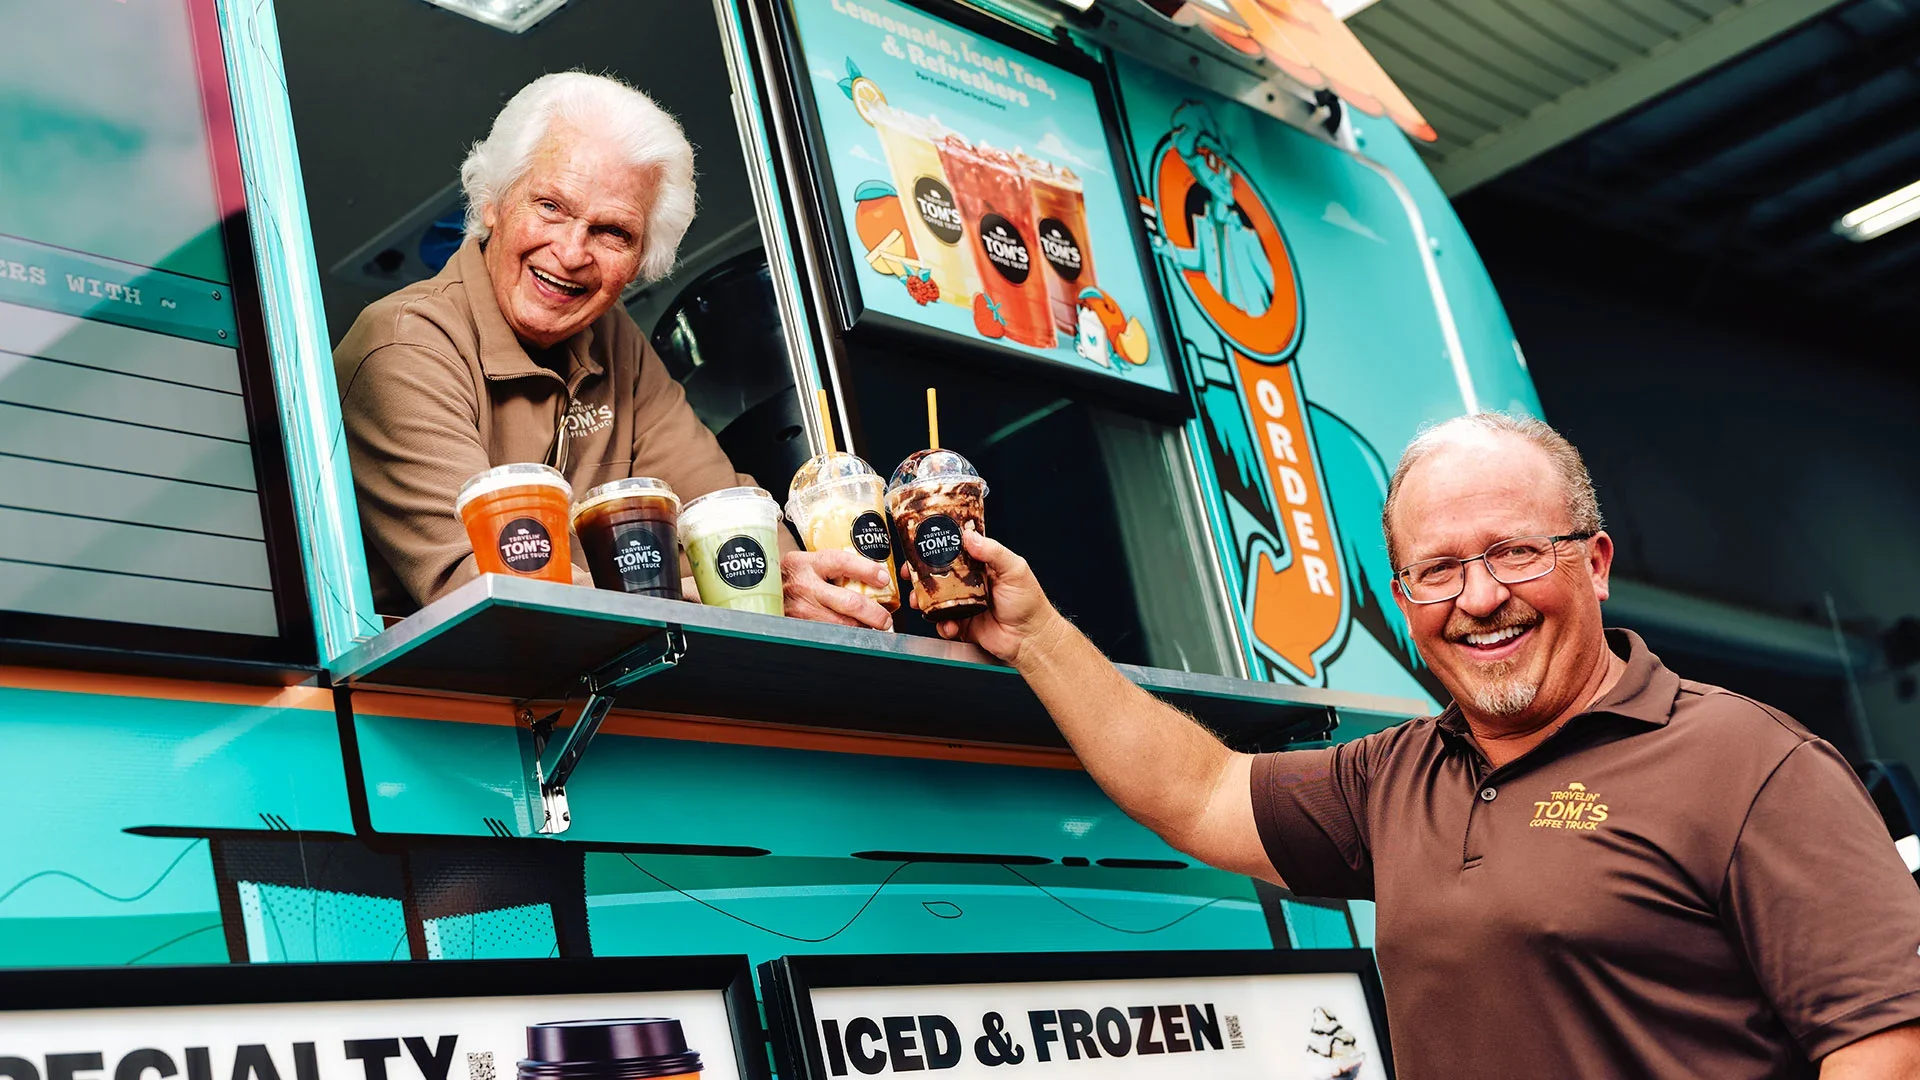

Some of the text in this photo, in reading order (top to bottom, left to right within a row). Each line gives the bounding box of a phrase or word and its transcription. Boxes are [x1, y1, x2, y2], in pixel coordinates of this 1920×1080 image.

[831, 0, 1057, 101] Lemonade, Iced Tea,
[881, 34, 1030, 108] & Refreshers
[917, 197, 962, 225] TOM'S
[982, 235, 1029, 264] TOM'S
[1040, 236, 1081, 263] TOM'S
[65, 274, 142, 305] WITH
[564, 404, 613, 430] OM'S
[570, 430, 588, 438] FFEE
[1256, 379, 1335, 597] ORDER
[855, 532, 890, 545] TOM'S
[917, 534, 961, 552] TOM'S
[501, 539, 551, 557] TOM'S
[922, 548, 941, 558] COFFEE
[507, 553, 529, 563] COFFEE
[613, 550, 662, 568] TOM'S
[719, 557, 766, 574] TOM'S
[619, 564, 641, 574] COFFEE
[725, 570, 746, 579] COFFEE
[1534, 800, 1608, 822] TOM'S
[1529, 818, 1599, 831] COFFEE TRUCK
[821, 1003, 1225, 1076] ICED & FROZEN
